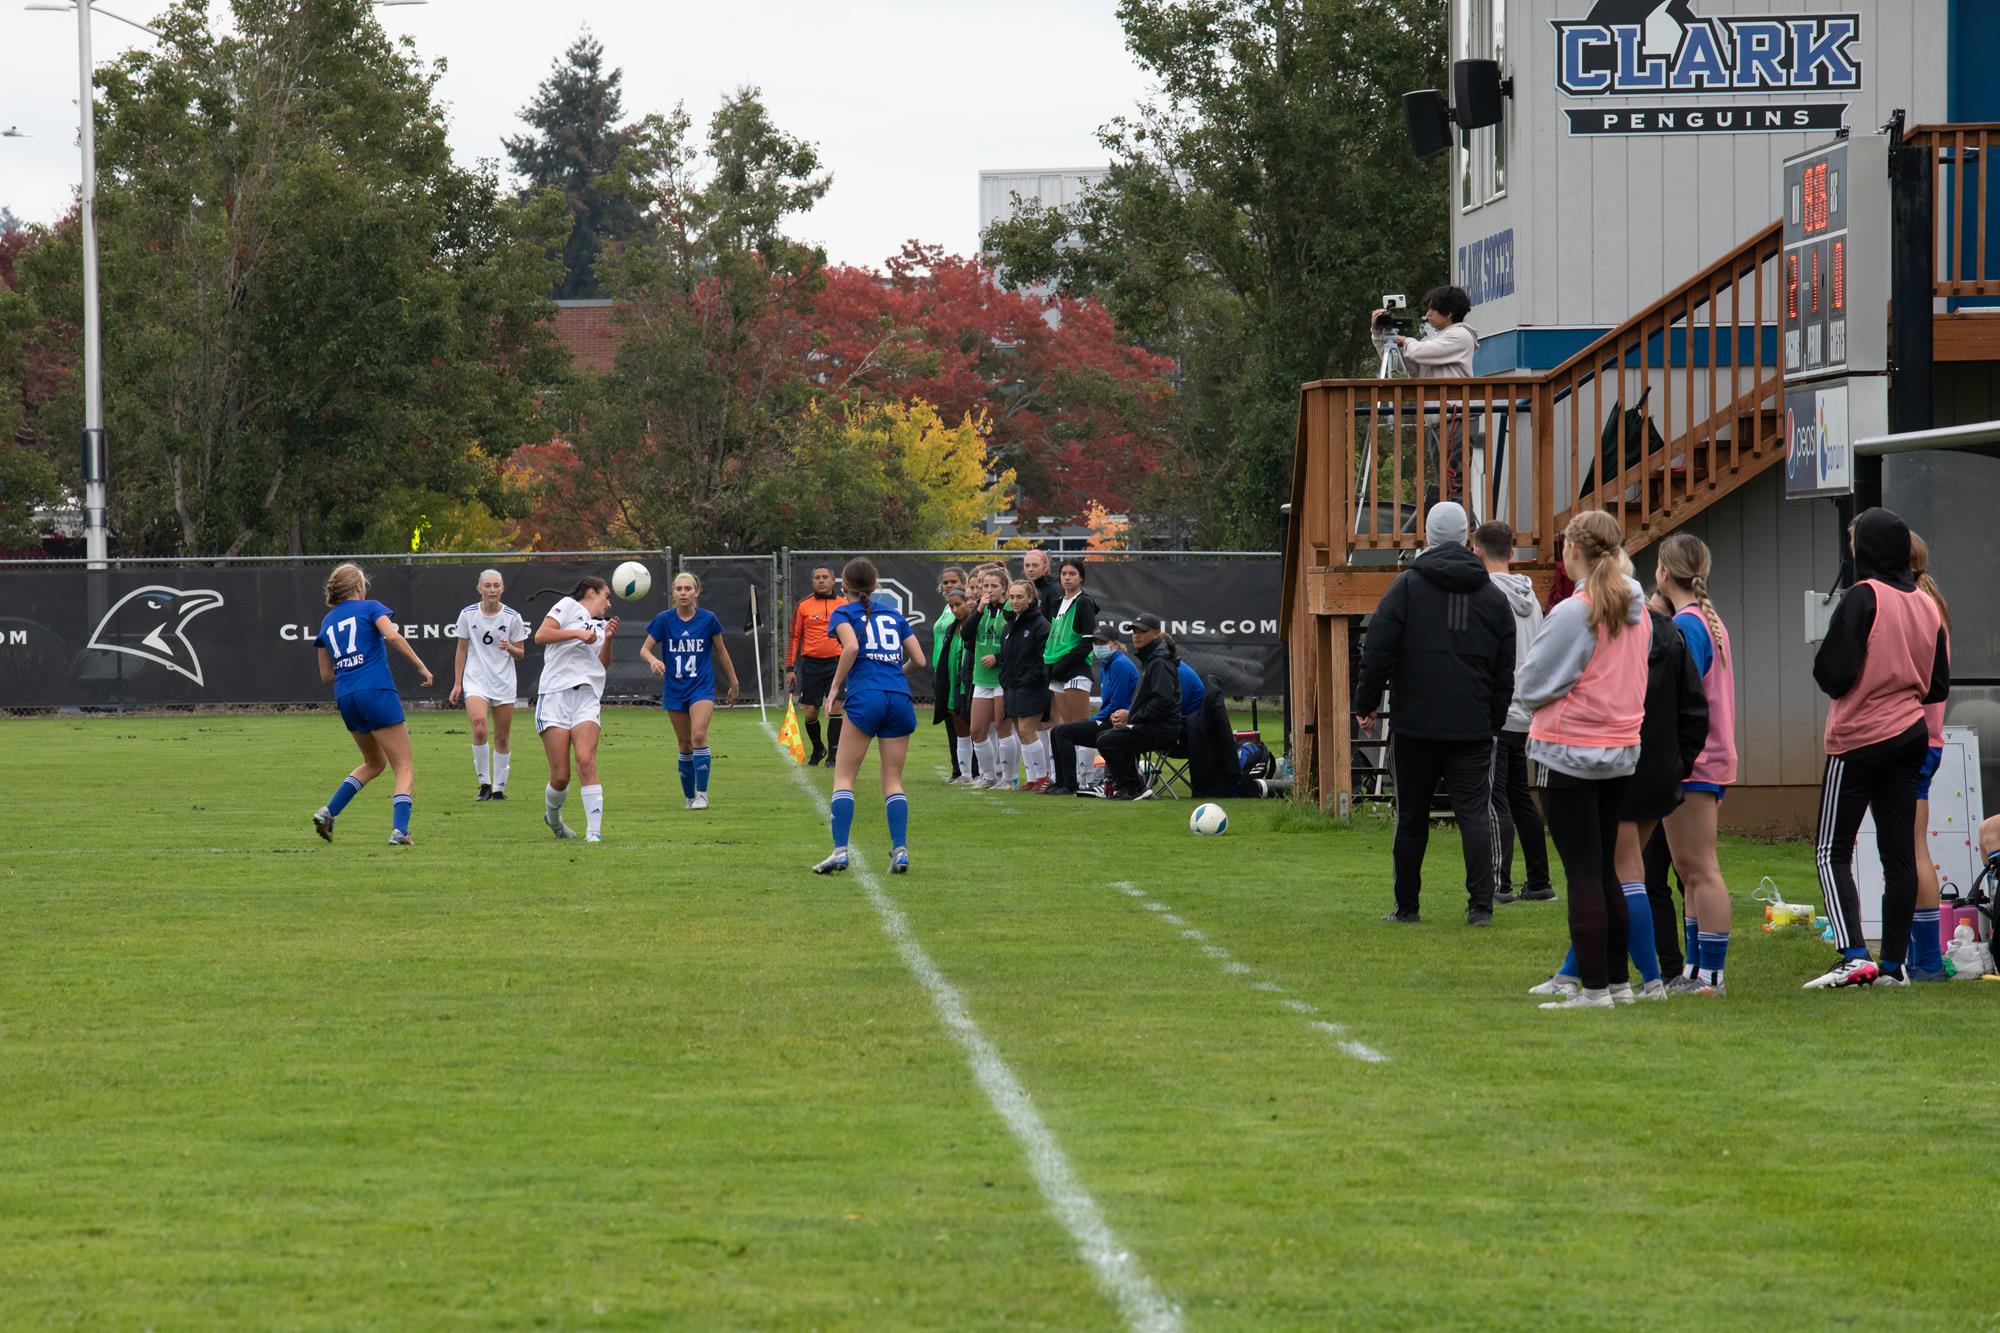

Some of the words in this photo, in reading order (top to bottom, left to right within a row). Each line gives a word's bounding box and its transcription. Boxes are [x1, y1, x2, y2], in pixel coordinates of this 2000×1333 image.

[1561, 20, 1856, 90] CLARK
[1603, 110, 1810, 129] PENGUINS
[1796, 416, 1817, 467] pepsi
[326, 616, 357, 659] 17
[482, 631, 494, 645] 6
[669, 638, 704, 653] LANE
[861, 615, 900, 651] 16
[675, 655, 698, 679] 14
